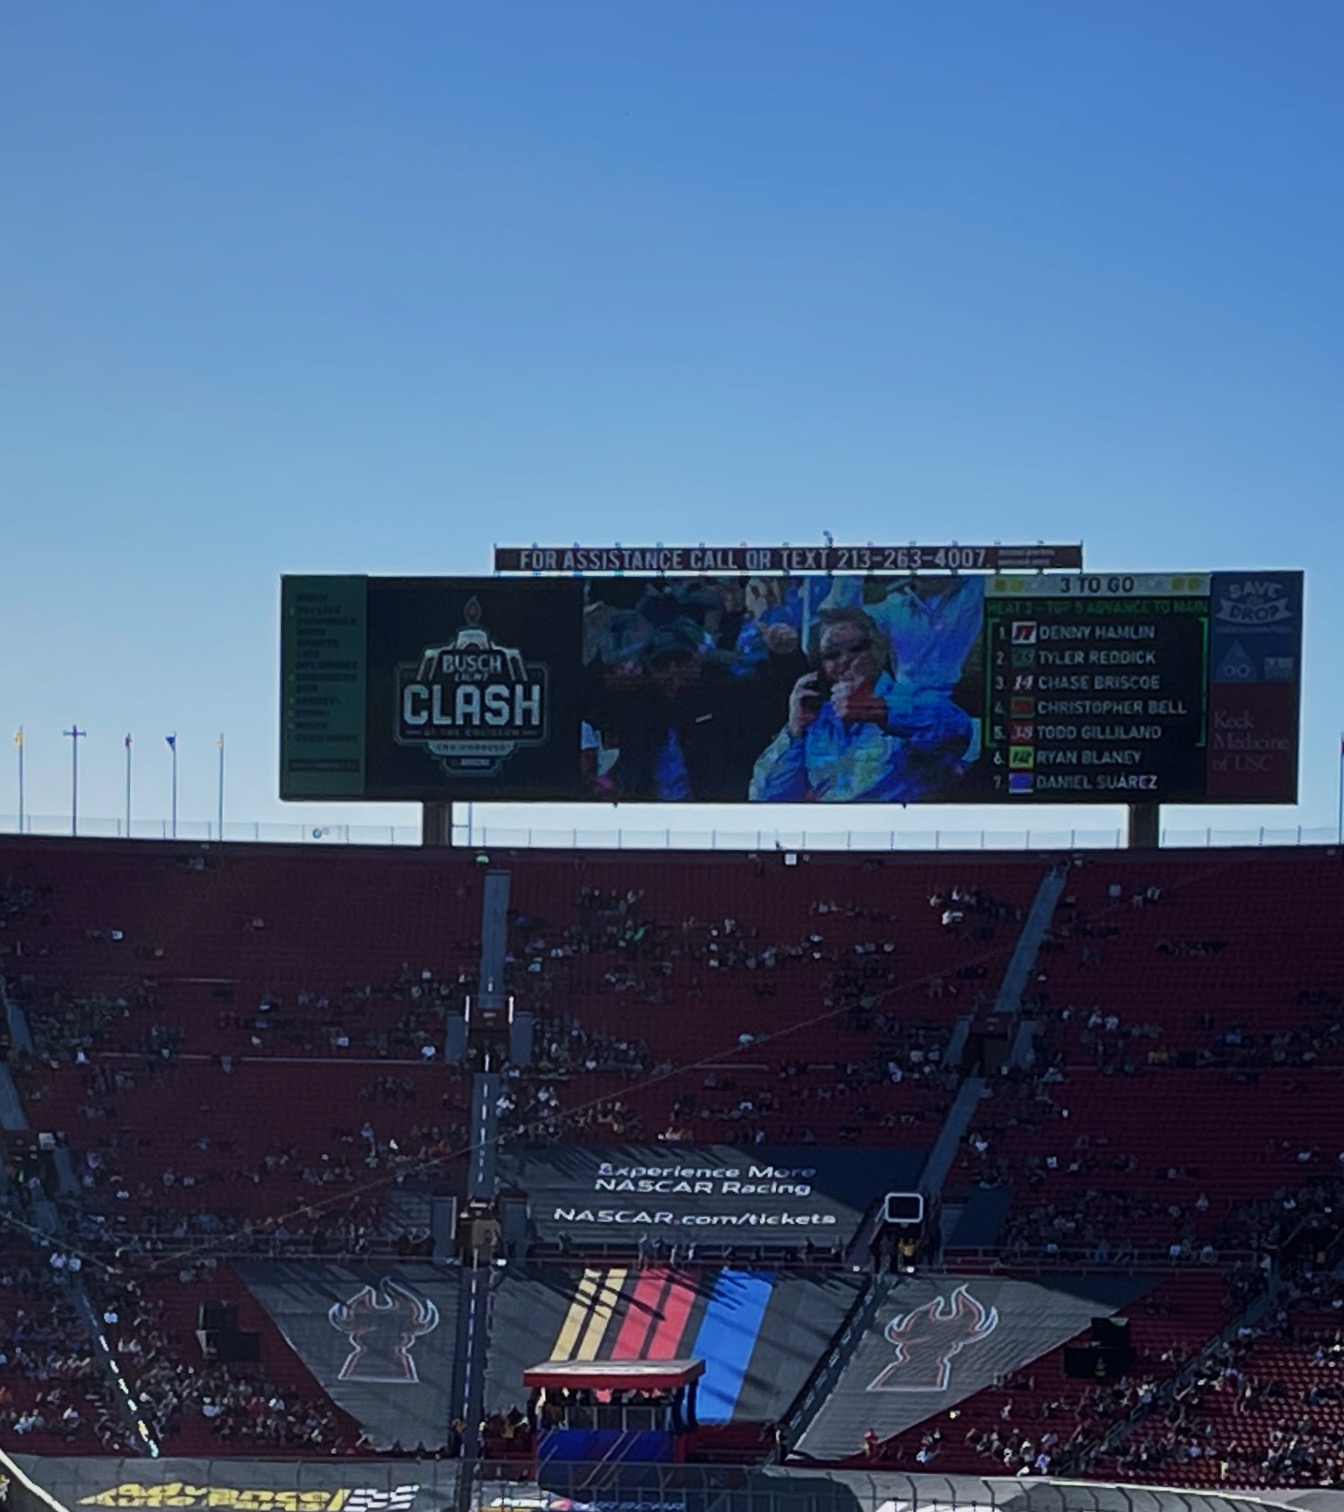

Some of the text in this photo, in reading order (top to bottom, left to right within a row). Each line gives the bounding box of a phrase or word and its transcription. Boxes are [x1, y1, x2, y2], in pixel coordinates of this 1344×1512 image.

[520, 549, 557, 570] FOR
[563, 549, 684, 570] ASSISTANCE
[689, 549, 738, 570] CALL
[745, 549, 772, 570] OR
[779, 549, 829, 569] TEXT
[1059, 577, 1135, 593] 3 TO GO
[1228, 603, 1279, 621] DROP
[1038, 626, 1092, 640] DENNY
[1095, 626, 1156, 640] HAMLIN
[441, 653, 503, 675] BUSCH
[1038, 651, 1085, 666] TYLER
[1089, 651, 1157, 665] REDDICK
[1037, 675, 1090, 690] CHASE
[1094, 675, 1161, 690] BRISCOE
[402, 683, 542, 727] CLASH
[1037, 701, 1144, 715] CHRISTOPHER
[1147, 701, 1188, 715] BELL
[1037, 726, 1077, 740] TODD
[1081, 726, 1163, 740] GILLILAND
[1036, 751, 1077, 765] RYAN
[1081, 751, 1143, 765] BLANEY
[1036, 775, 1092, 790] DANIEL
[1097, 771, 1159, 790] SUÁREZ
[597, 1162, 817, 1180] Experience More
[594, 1179, 812, 1197] NASCAR Racing
[553, 1207, 837, 1226] NASCAR.com/tickets
